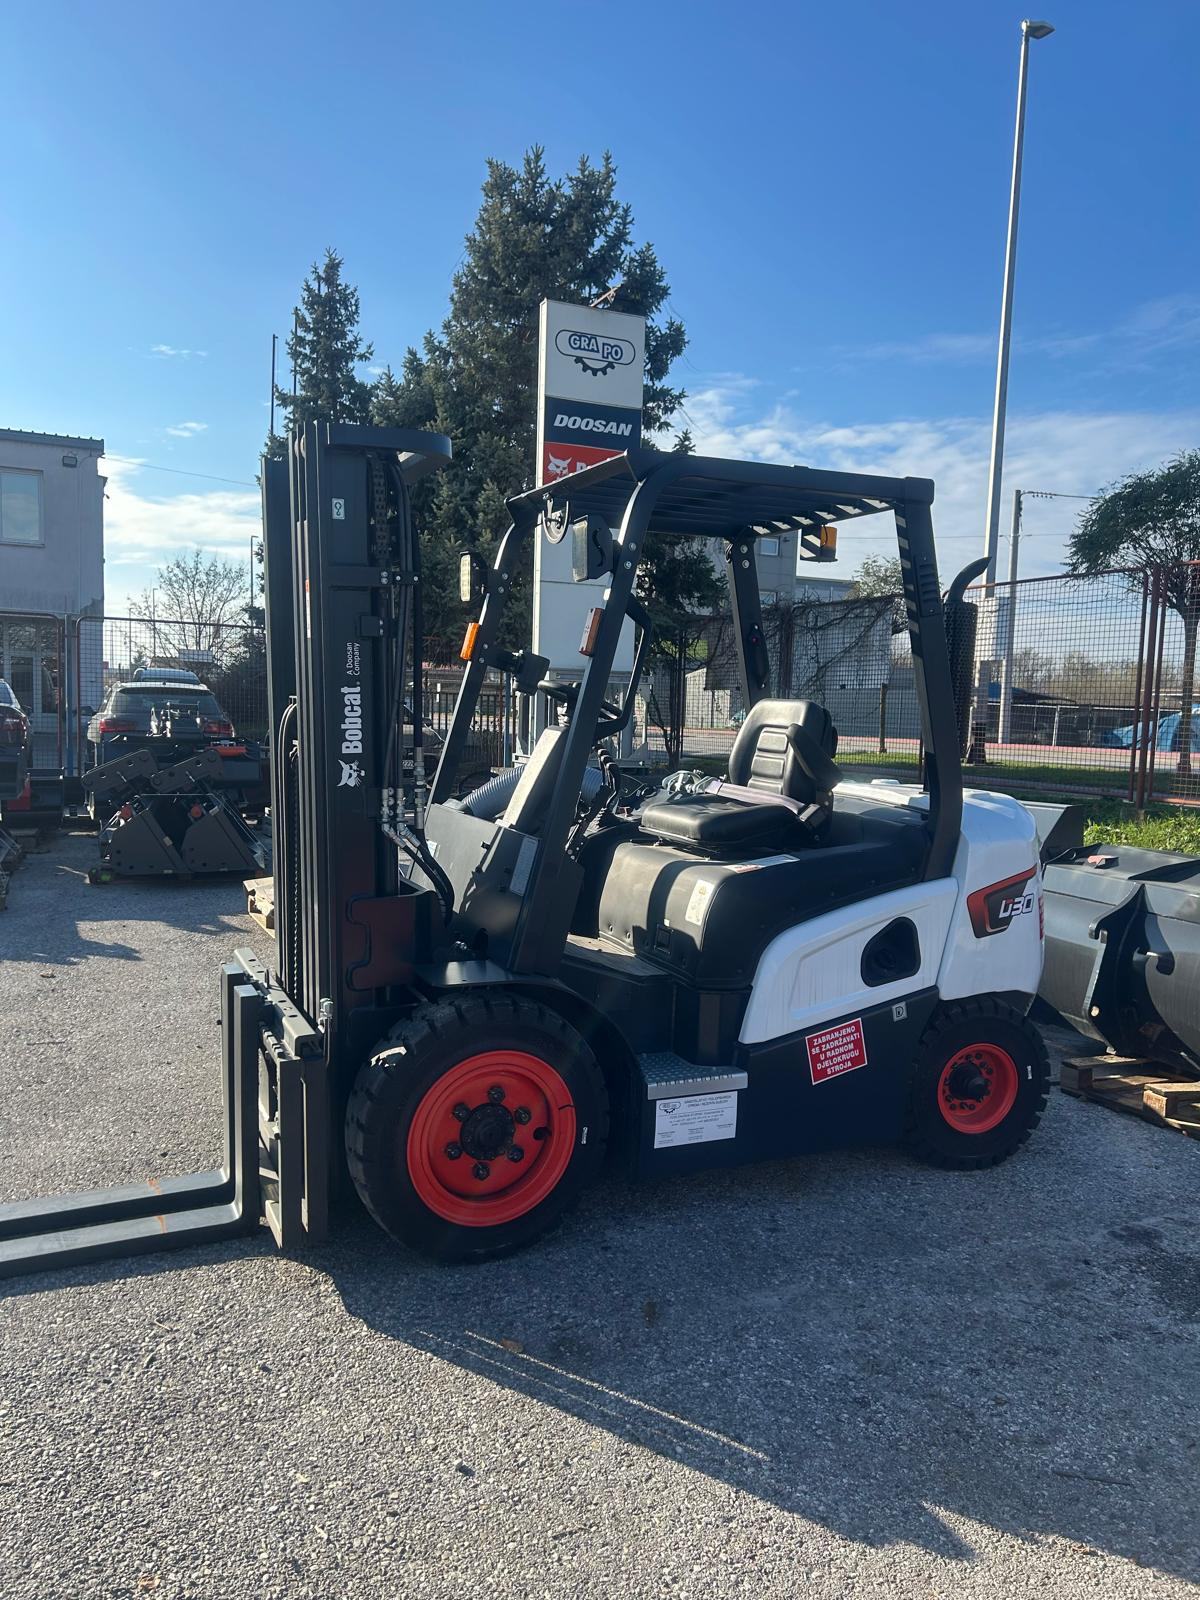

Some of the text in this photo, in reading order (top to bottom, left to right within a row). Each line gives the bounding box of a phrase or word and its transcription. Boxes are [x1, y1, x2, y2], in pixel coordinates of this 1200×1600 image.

[553, 414, 633, 436] DOOSAN
[340, 686, 363, 754] Bobcat
[813, 1026, 856, 1046] ZABRANJENO
[821, 1033, 860, 1051] ZADRŽAVATI
[826, 1043, 854, 1058] RADNOM
[817, 1051, 859, 1070] DJELOKRUGU
[827, 1061, 852, 1075] STROJA
